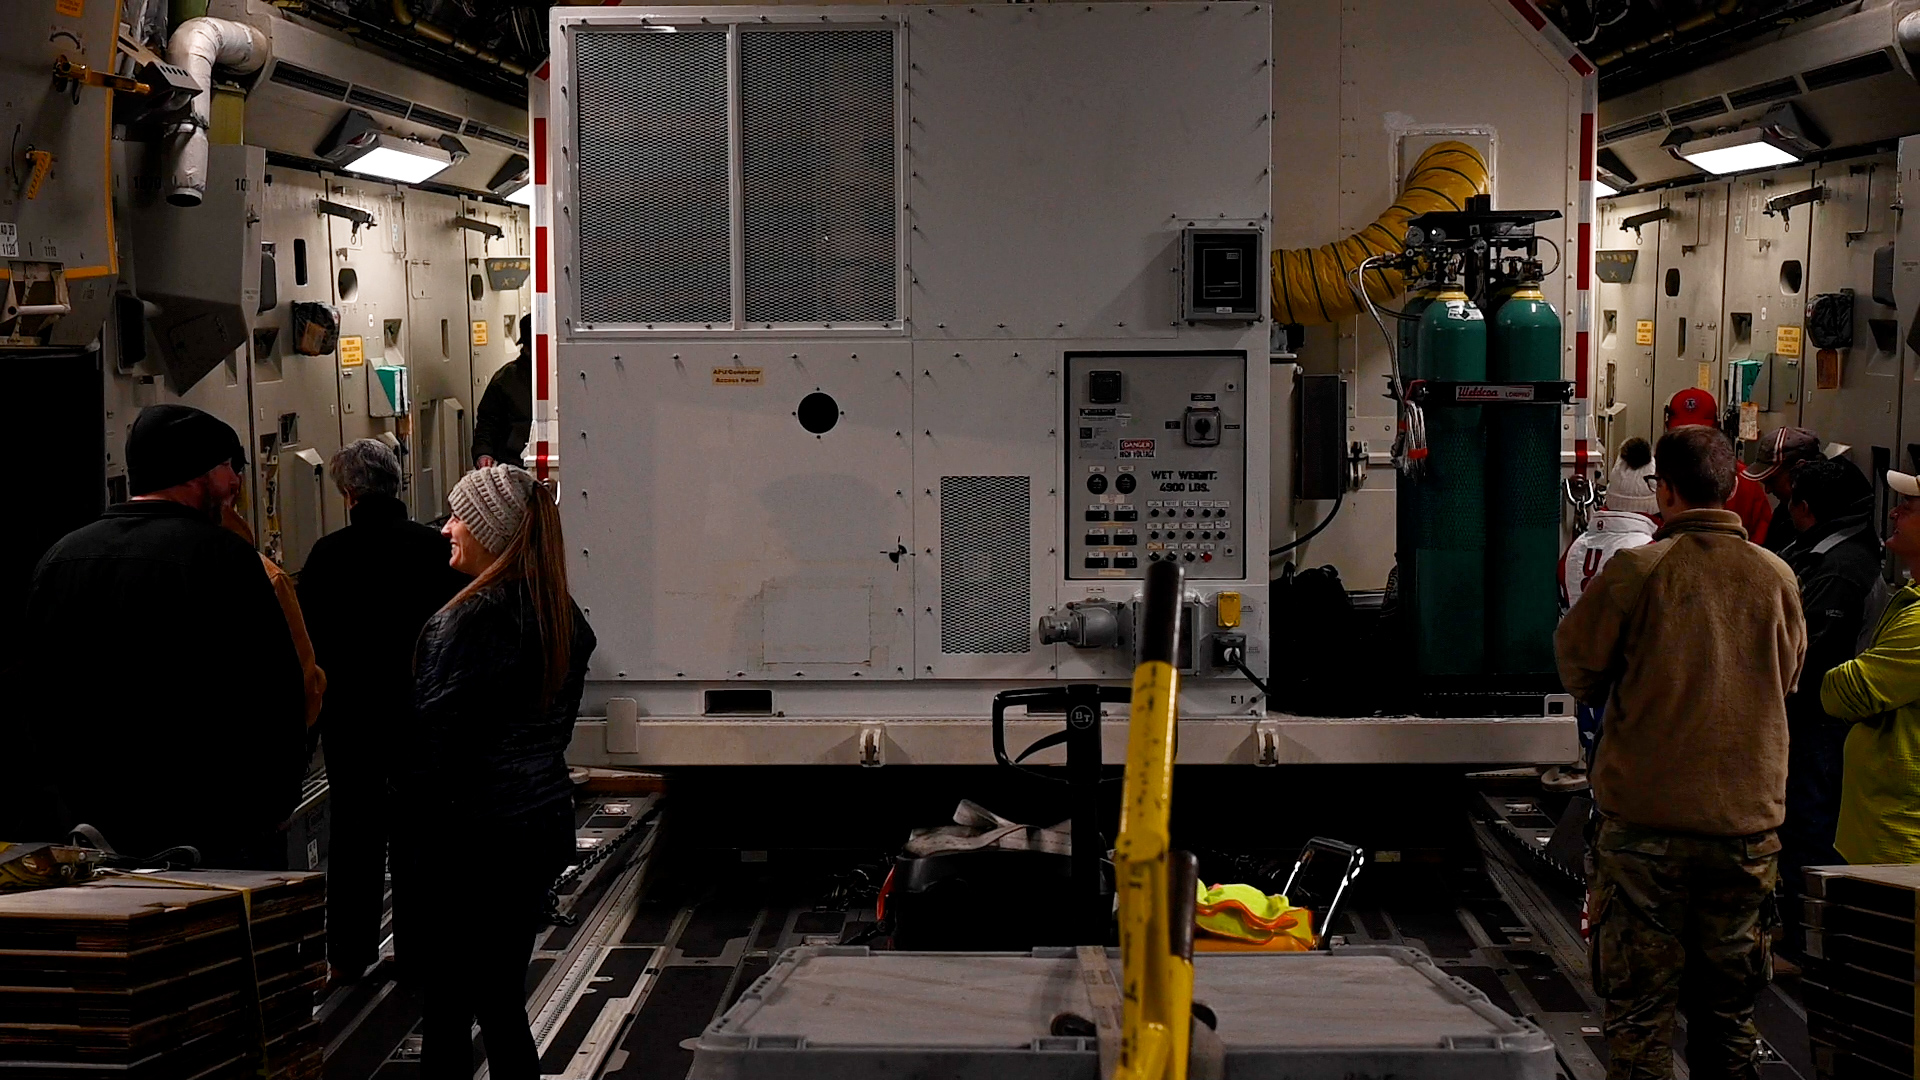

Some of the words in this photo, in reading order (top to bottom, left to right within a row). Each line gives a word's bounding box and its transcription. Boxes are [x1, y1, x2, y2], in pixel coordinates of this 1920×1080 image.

[1123, 441, 1151, 449] DANGER
[1151, 470, 1174, 480] WET
[1160, 482, 1185, 492] 4900
[1188, 482, 1210, 492] LBS.
